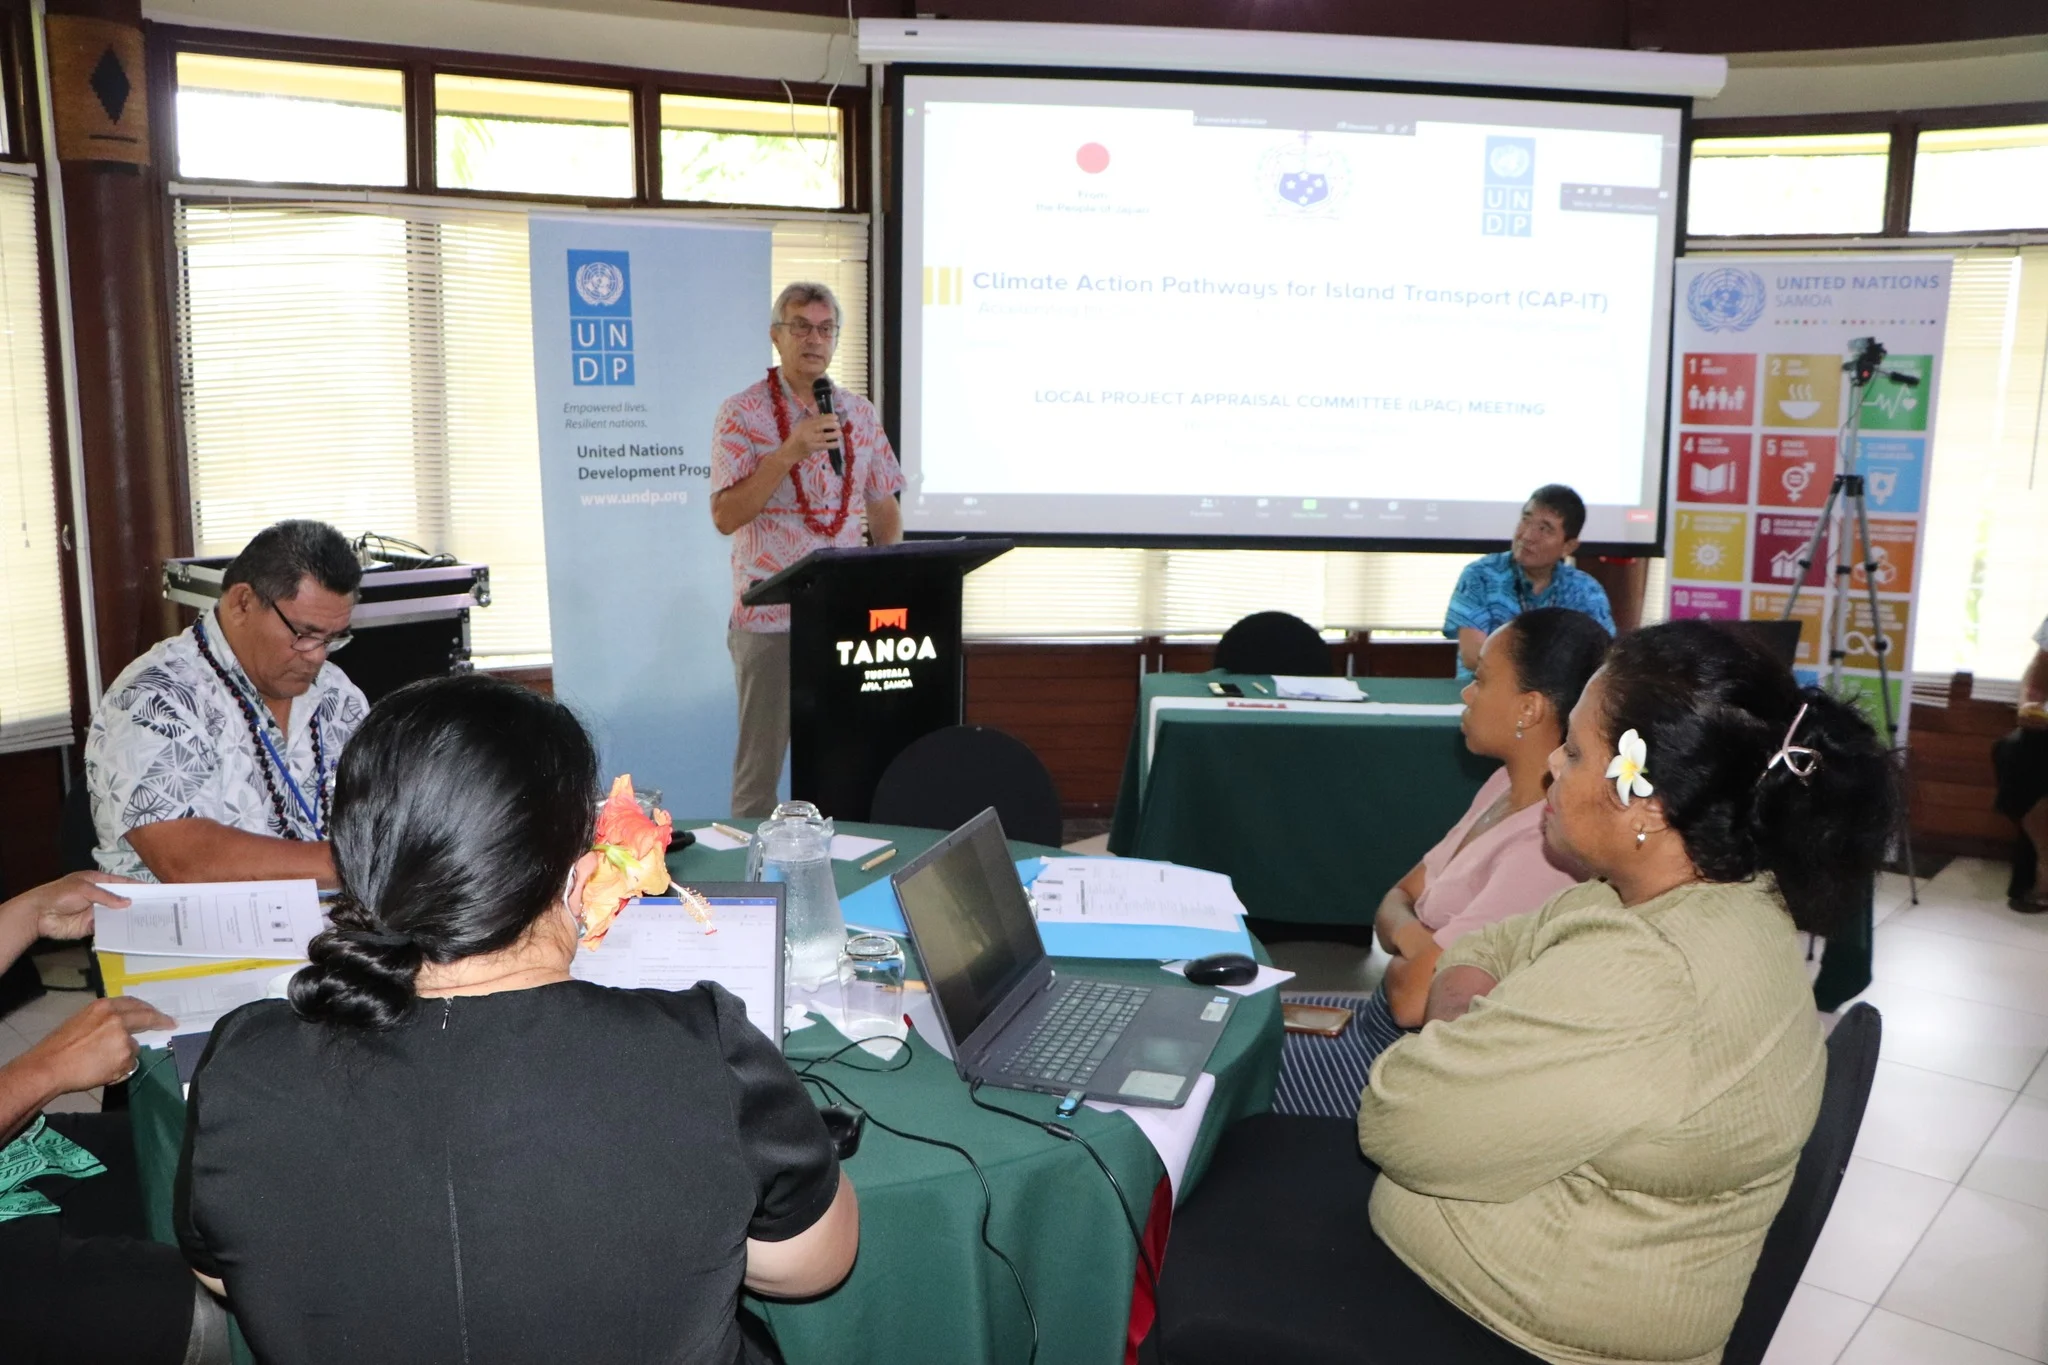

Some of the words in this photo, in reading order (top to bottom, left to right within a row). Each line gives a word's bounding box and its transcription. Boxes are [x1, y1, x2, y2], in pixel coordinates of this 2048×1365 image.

[1776, 276, 1845, 290] UNITED
[1852, 275, 1940, 289] NATIONS
[973, 272, 1068, 290] Climate
[1076, 274, 1153, 293] Action
[1162, 276, 1278, 299] Pathways
[1287, 280, 1316, 297] for
[1326, 282, 1395, 300] Island
[1405, 284, 1511, 307] Transport
[1518, 290, 1609, 313] (CAP-IT)
[1775, 294, 1832, 308] SAMOA
[1688, 358, 1697, 374] 1
[1771, 359, 1781, 376] 2
[563, 403, 622, 415] Empowered
[624, 402, 648, 413] lives.
[1035, 391, 1095, 404] LOCAL
[1102, 391, 1183, 405] PROJECT
[1191, 393, 1290, 407] APPRAISAL
[1297, 395, 1402, 410] COMMITTEE
[1409, 399, 1463, 413] (LPAC)
[1469, 400, 1545, 415] MEETING
[565, 419, 606, 430] Resilient
[608, 418, 648, 428] nations.
[577, 445, 626, 458] United
[629, 444, 684, 457] Nations
[1683, 437, 1694, 453] 4
[1766, 440, 1777, 456] 5
[578, 466, 676, 481] Development
[580, 489, 688, 506] www.undp.org
[1674, 590, 1690, 607] 10
[836, 635, 938, 666] TANOA
